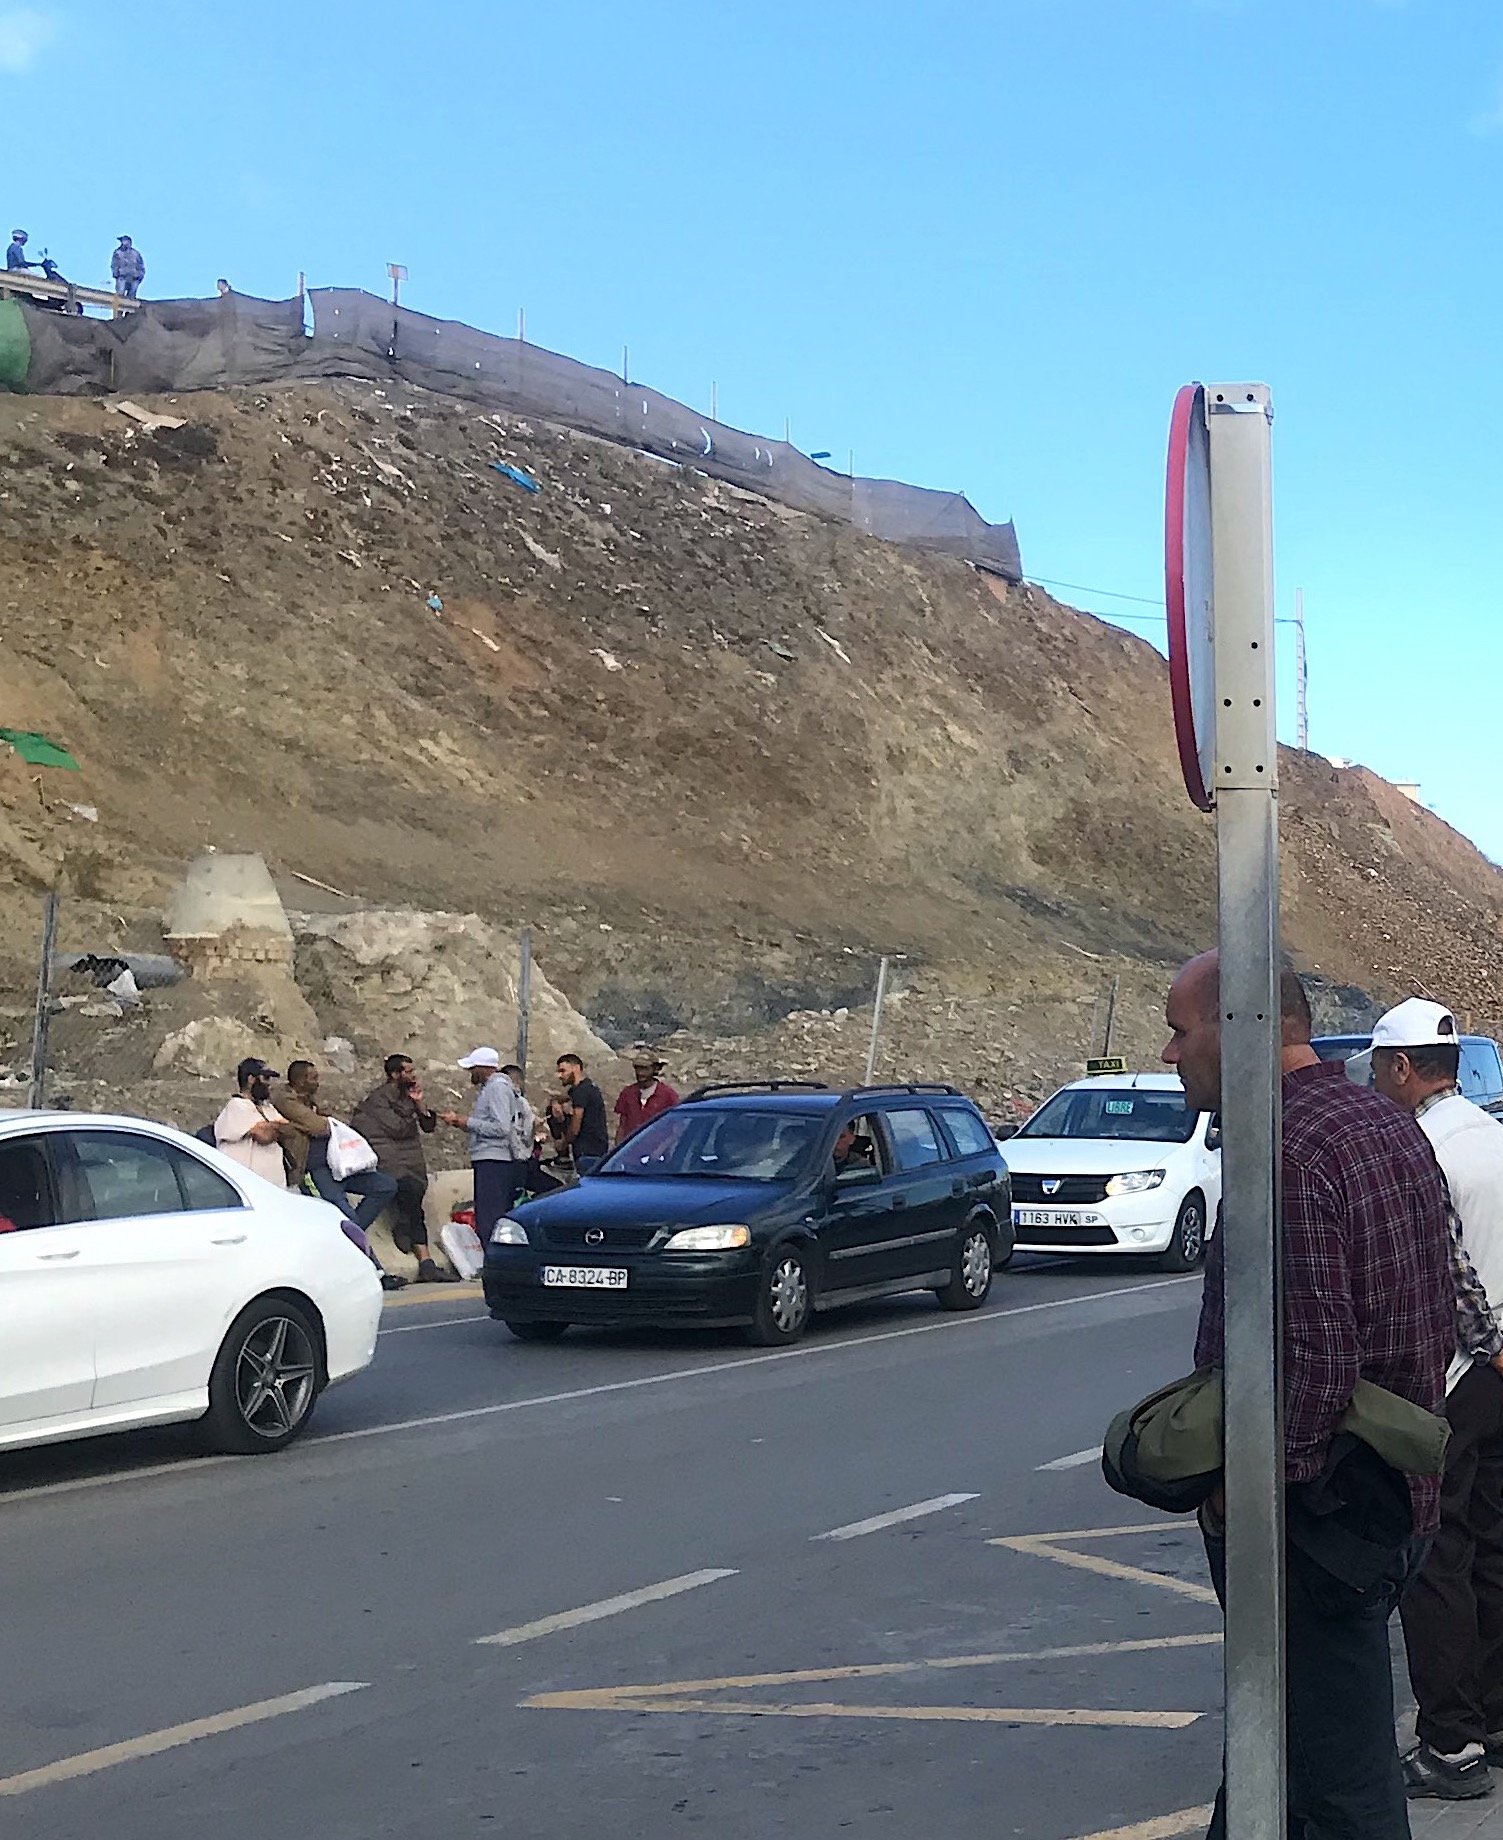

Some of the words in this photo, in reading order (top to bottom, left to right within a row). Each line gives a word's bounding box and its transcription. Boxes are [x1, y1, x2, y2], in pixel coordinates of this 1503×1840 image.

[1098, 1060, 1120, 1069] TAXI
[1107, 1101, 1131, 1113] LIBRE
[1022, 1212, 1049, 1224] 1163
[1085, 1215, 1098, 1224] SP
